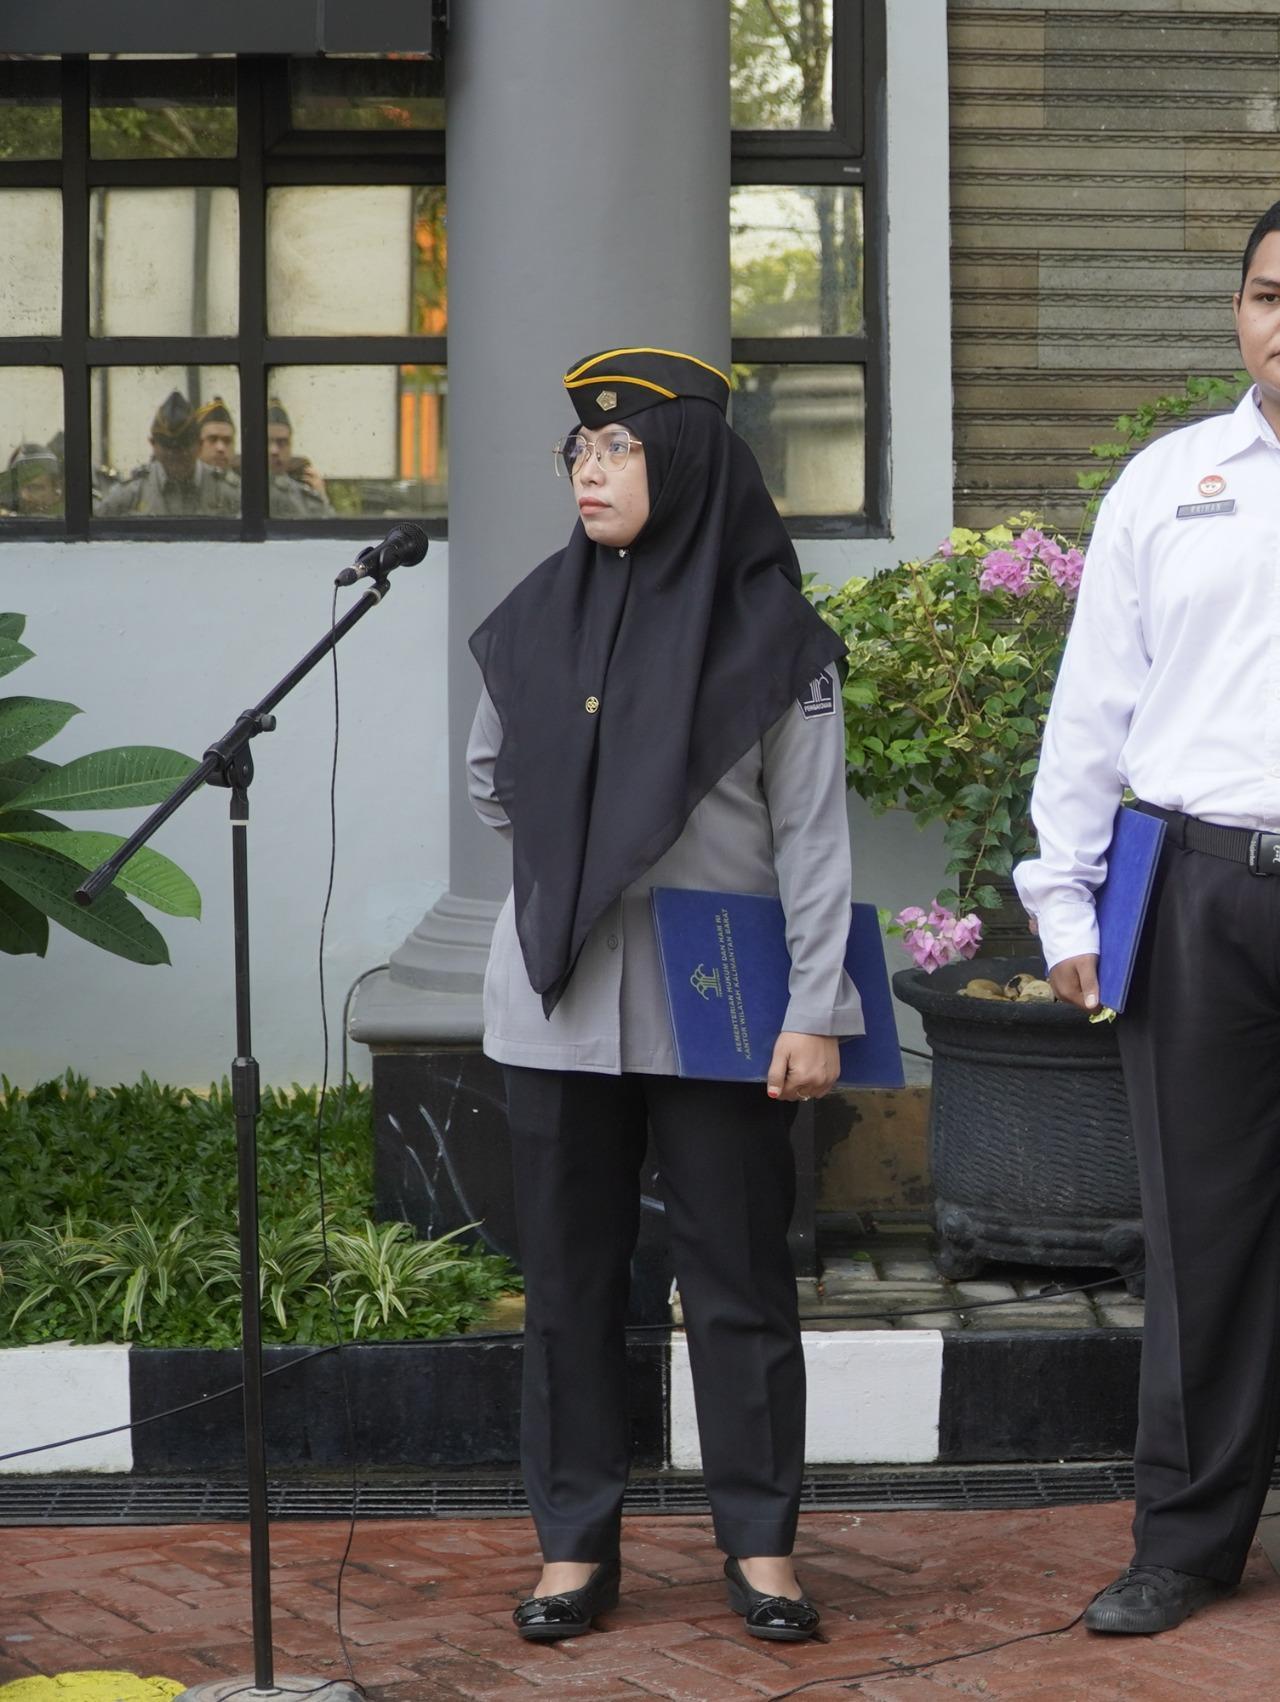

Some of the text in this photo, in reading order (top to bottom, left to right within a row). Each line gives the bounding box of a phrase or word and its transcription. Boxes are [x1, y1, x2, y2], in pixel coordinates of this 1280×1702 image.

[720, 945, 728, 961] DAN
[722, 963, 733, 992] HUKUM
[722, 908, 752, 1060] KANTOR WILAYAH KALIMANTAN BARAT
[728, 995, 742, 1052] KEMENTERIAN
